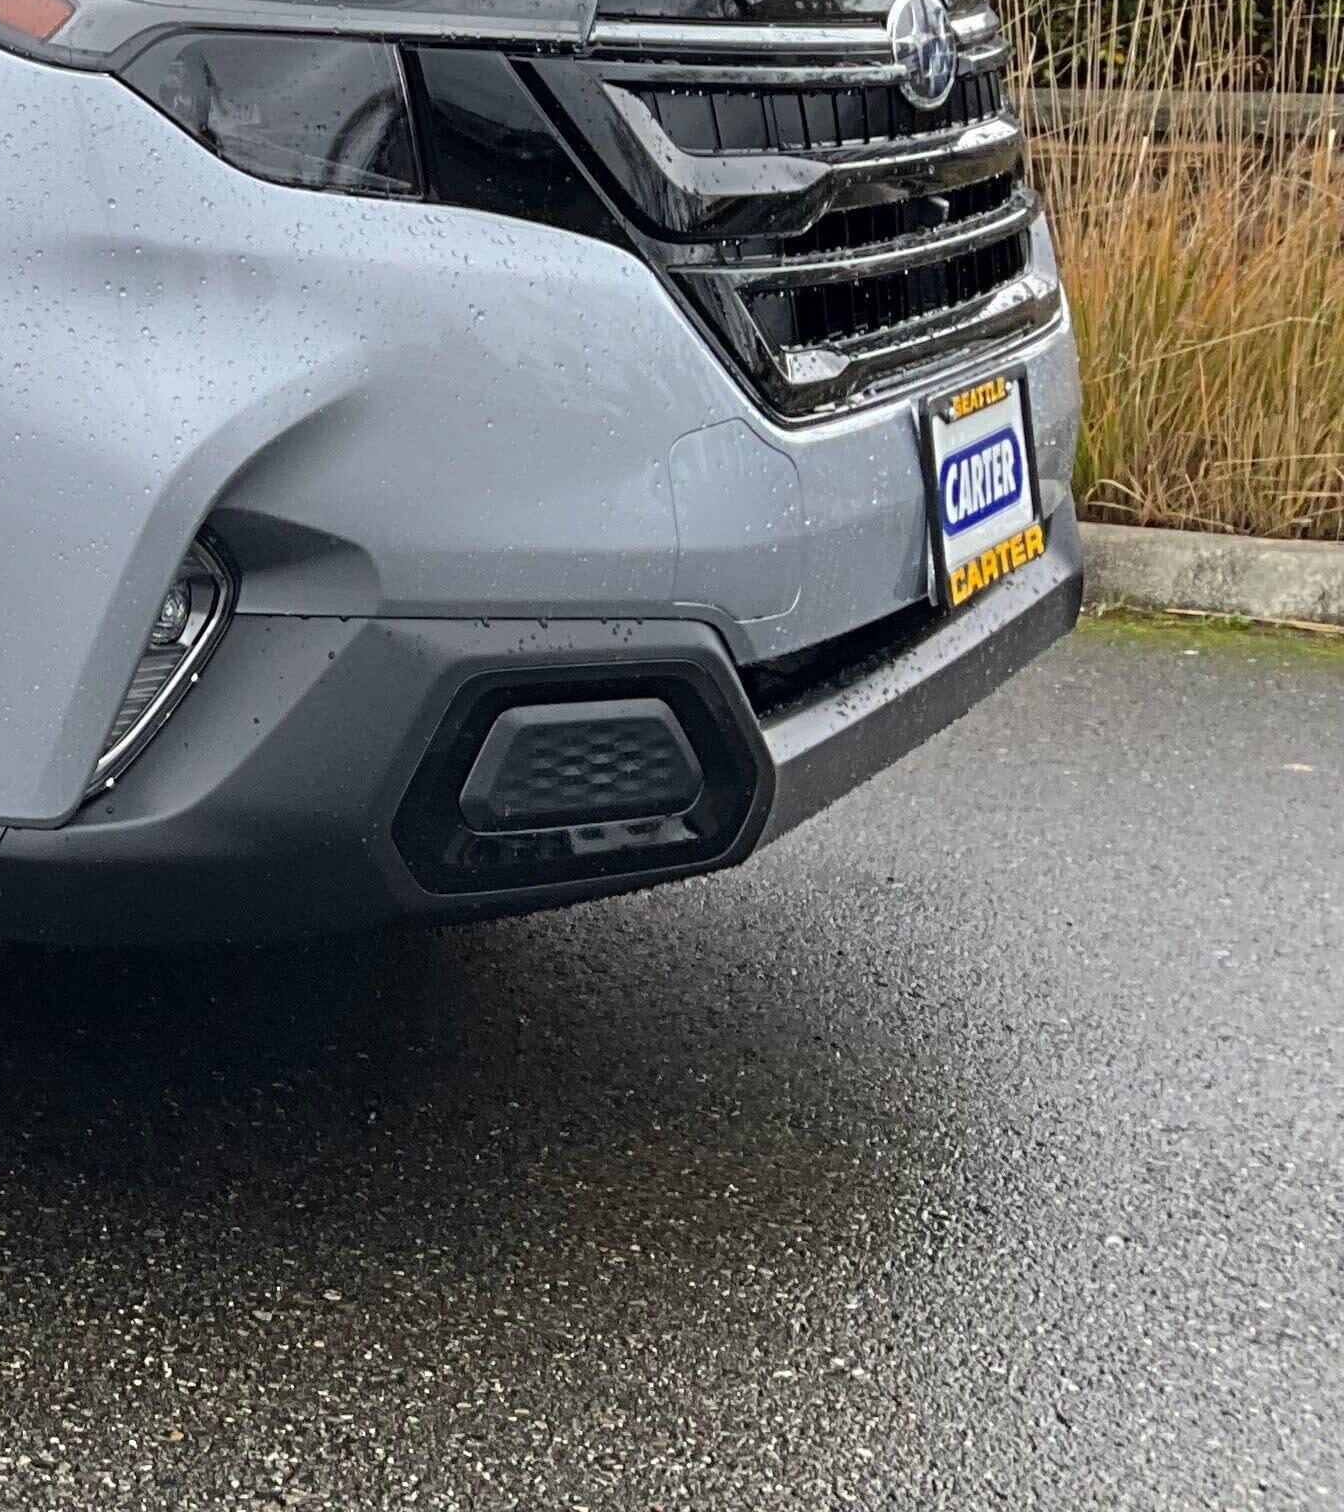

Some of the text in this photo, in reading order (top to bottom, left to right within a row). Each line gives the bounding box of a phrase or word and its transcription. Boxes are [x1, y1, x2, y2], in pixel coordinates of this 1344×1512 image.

[952, 376, 1008, 418] SEATTLE
[945, 438, 1017, 525] CARTER
[949, 523, 1046, 606] CARTER
